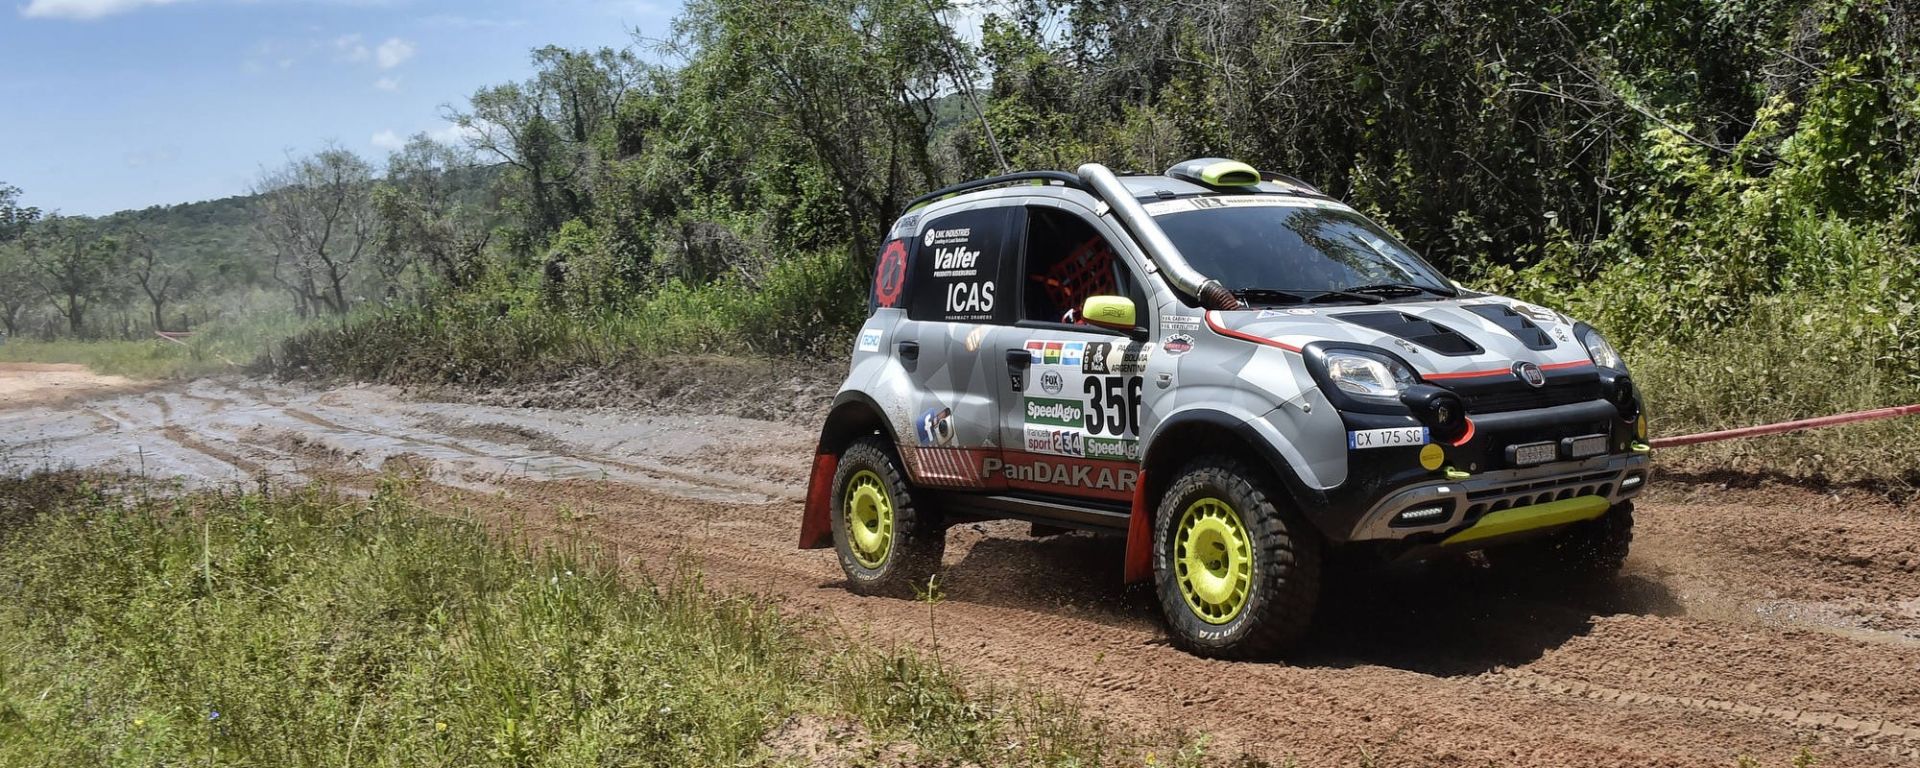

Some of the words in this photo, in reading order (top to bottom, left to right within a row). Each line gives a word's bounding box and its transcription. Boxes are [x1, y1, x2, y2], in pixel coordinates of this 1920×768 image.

[934, 246, 981, 270] Valfer
[946, 281, 995, 313] ICAS
[1045, 374, 1058, 386] FOX
[1027, 401, 1081, 422] SpeedAgro
[1083, 375, 1143, 437] 356
[1028, 438, 1051, 450] sport
[1356, 432, 1372, 446] CX
[1381, 429, 1401, 445] 175
[1406, 429, 1421, 443] SG
[1087, 438, 1139, 459] SpeedAgr
[982, 458, 1137, 492] PanDAKAR
